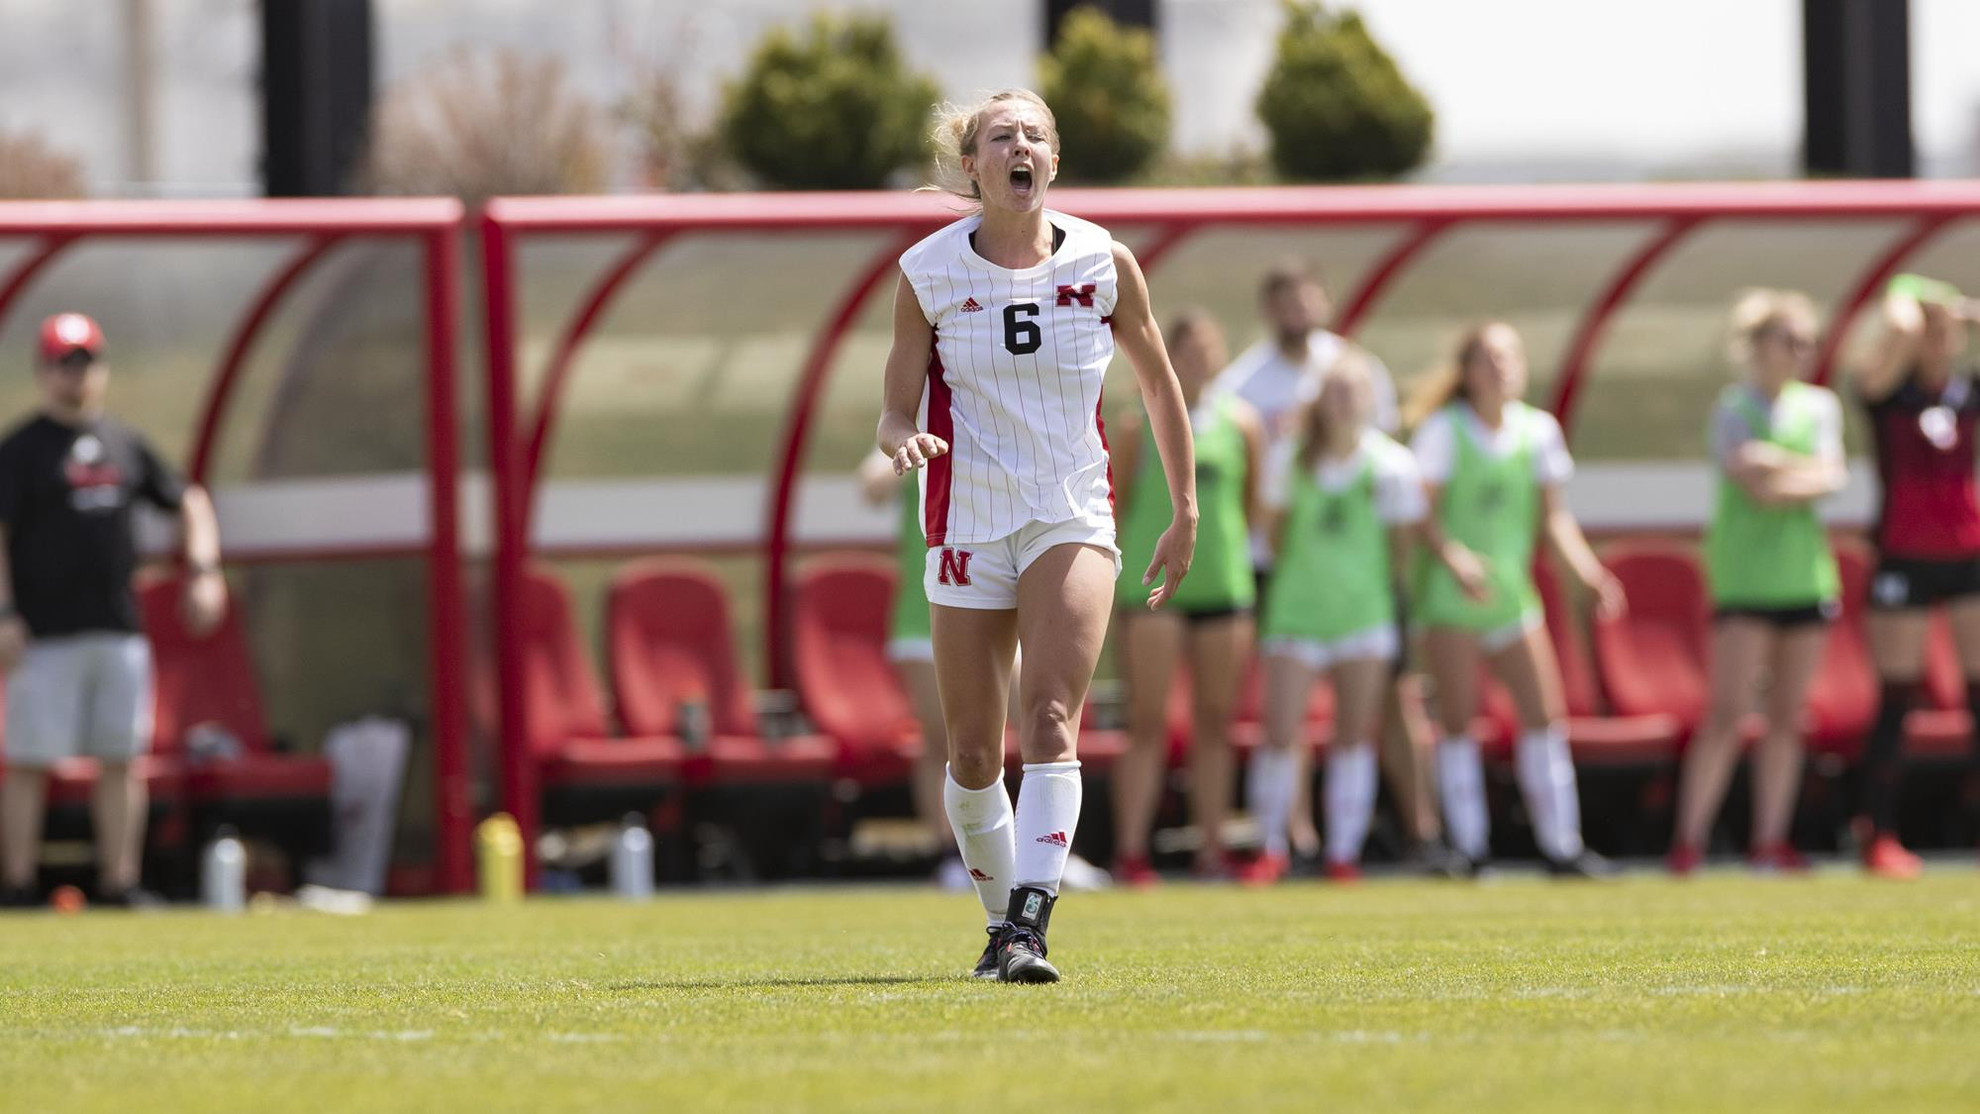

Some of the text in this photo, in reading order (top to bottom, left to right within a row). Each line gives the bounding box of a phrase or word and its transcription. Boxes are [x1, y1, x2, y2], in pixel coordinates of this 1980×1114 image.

[1056, 281, 1097, 308] N
[1003, 303, 1042, 355] 6
[938, 547, 974, 586] N
[1035, 835, 1067, 848] adida
